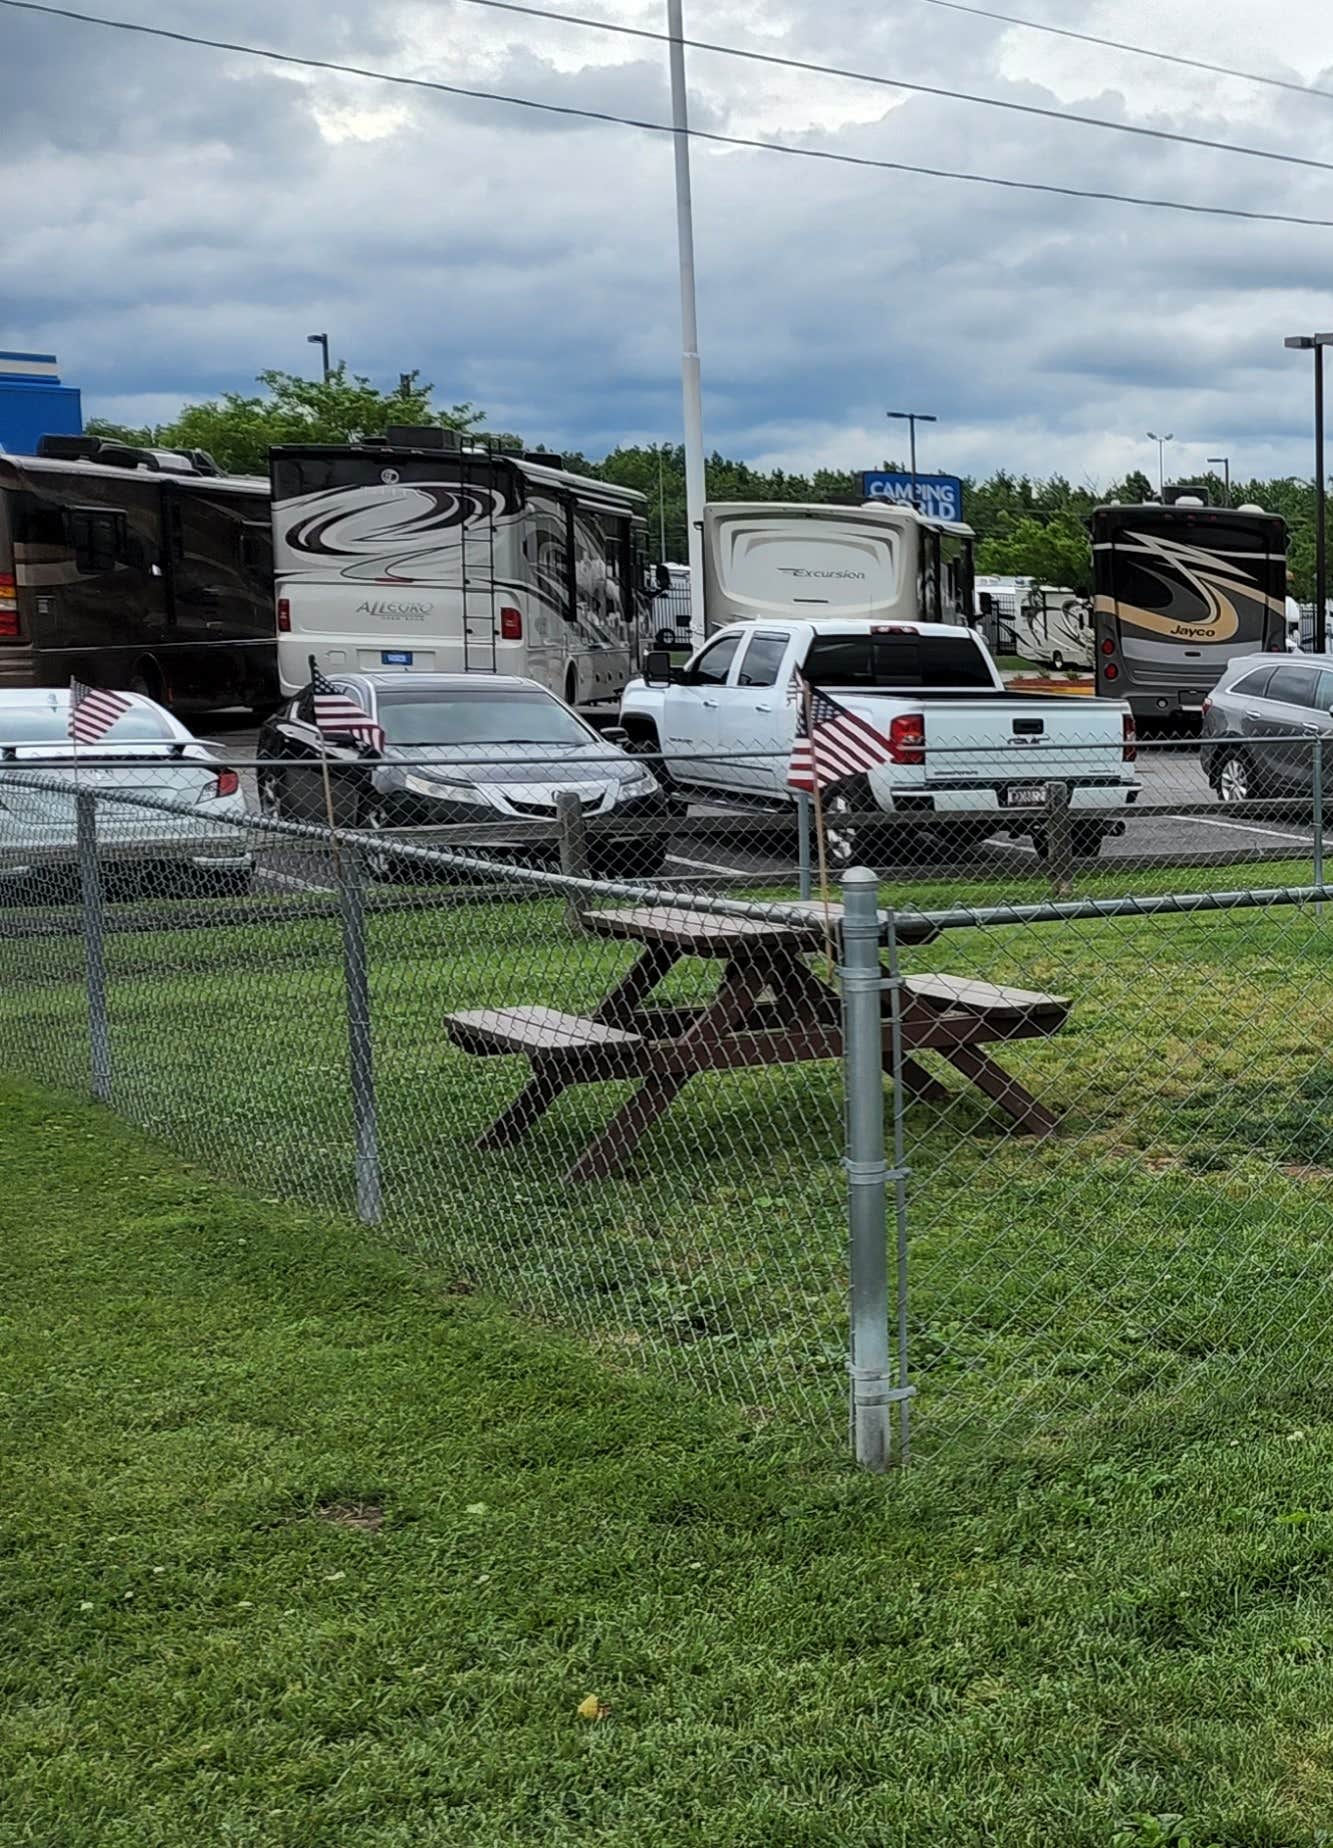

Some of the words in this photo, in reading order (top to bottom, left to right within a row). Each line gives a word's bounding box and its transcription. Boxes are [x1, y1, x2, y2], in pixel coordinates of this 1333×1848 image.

[777, 568, 865, 579] Excursion
[356, 601, 434, 616] ALLEGRO
[1170, 625, 1216, 637] Jayco
